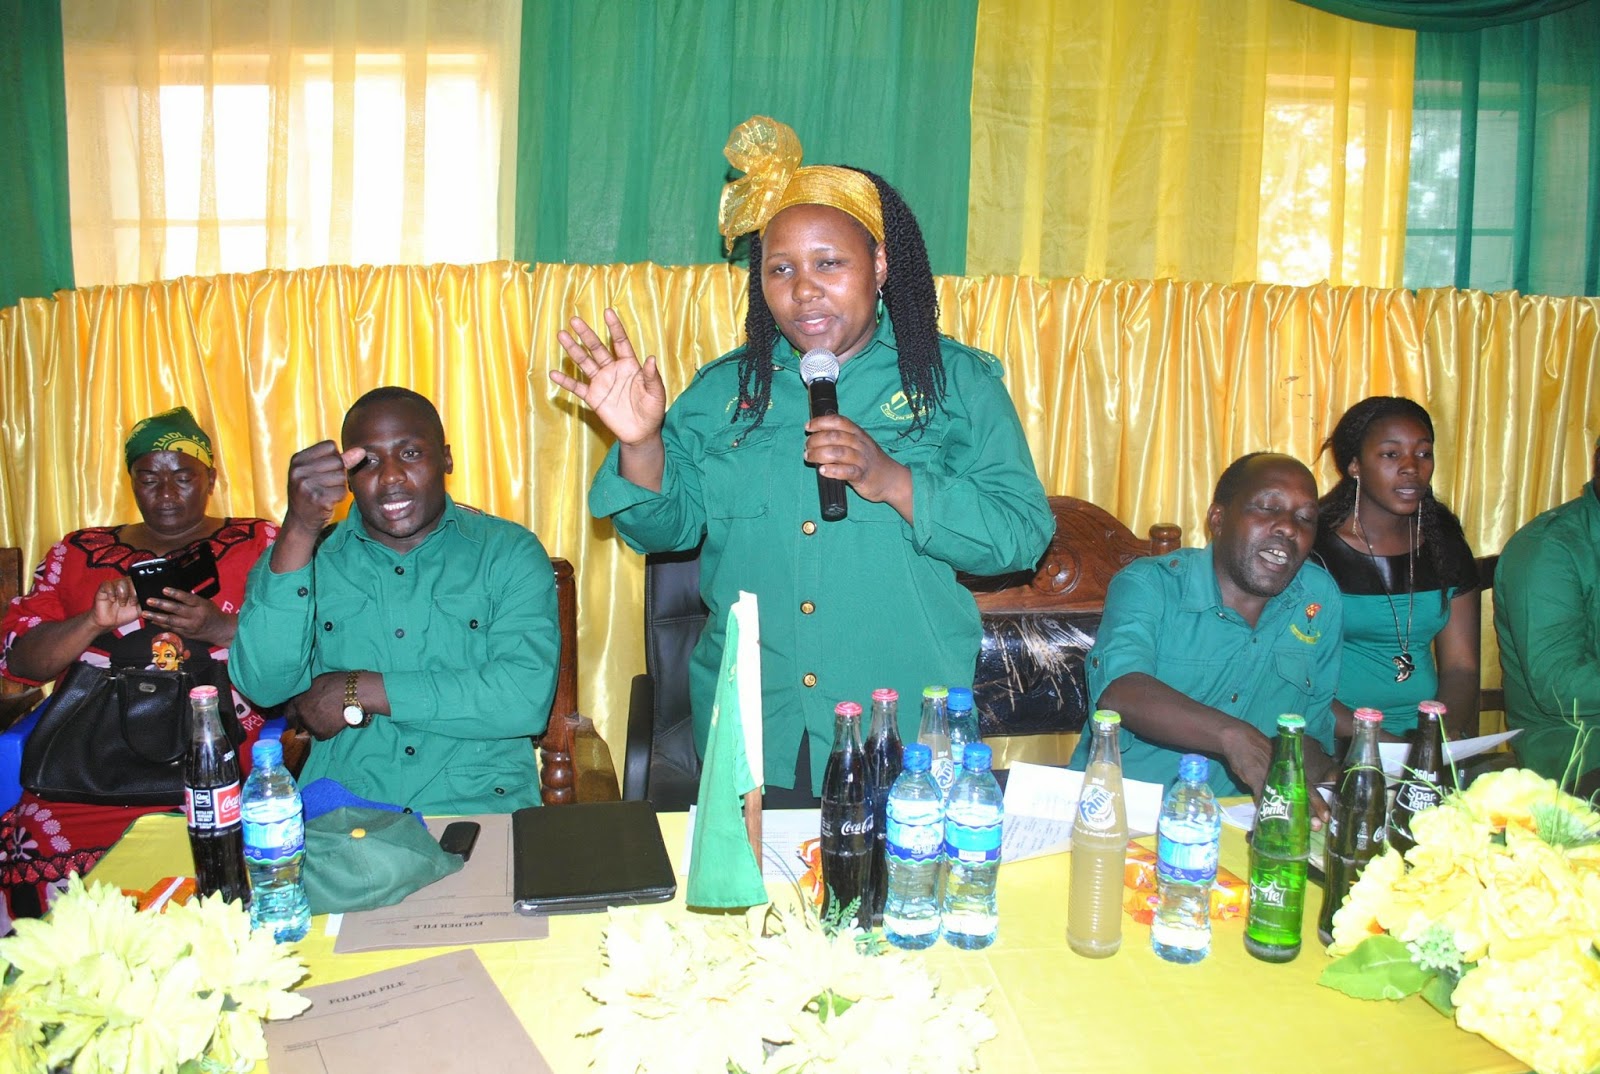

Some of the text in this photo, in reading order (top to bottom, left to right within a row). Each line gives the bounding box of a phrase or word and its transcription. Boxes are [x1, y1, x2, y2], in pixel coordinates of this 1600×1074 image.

[1260, 802, 1286, 818] Sprite
[413, 920, 484, 930] FOLDER FILE
[329, 987, 378, 1005] FOLDER
[380, 980, 407, 993] FILE
